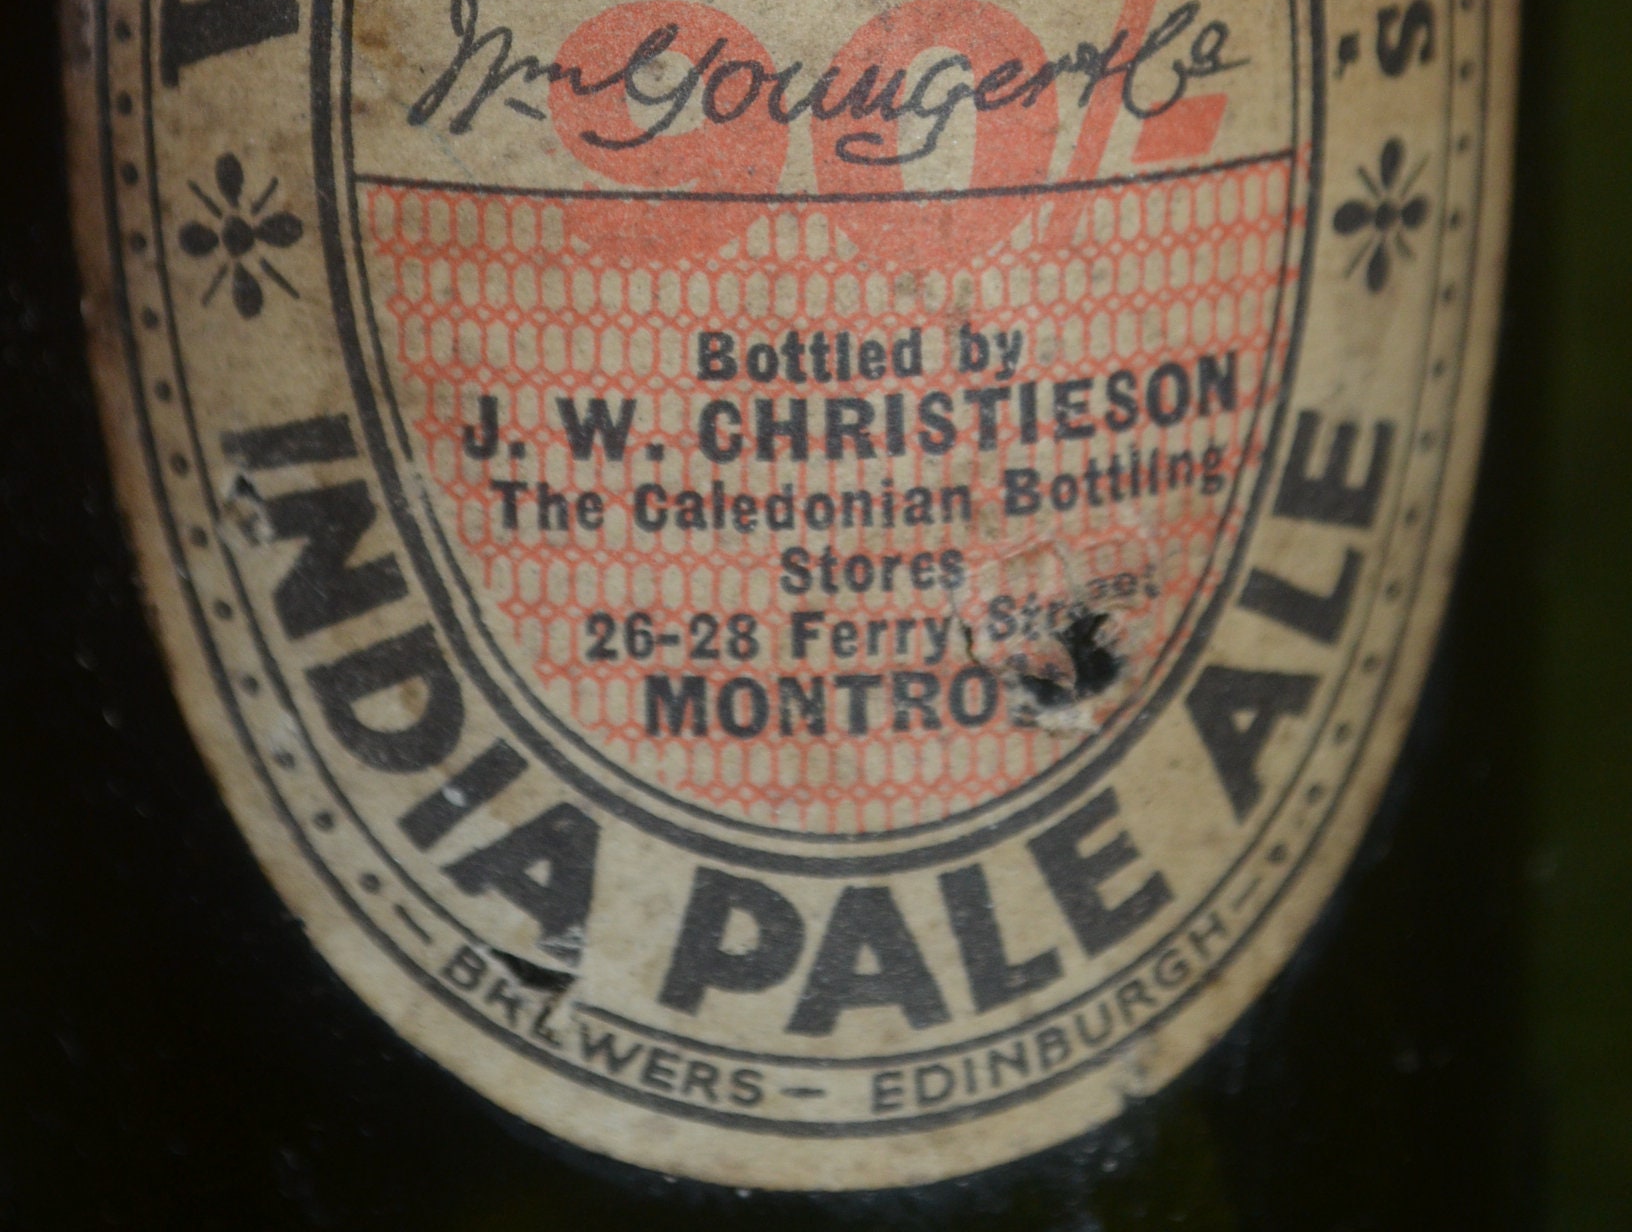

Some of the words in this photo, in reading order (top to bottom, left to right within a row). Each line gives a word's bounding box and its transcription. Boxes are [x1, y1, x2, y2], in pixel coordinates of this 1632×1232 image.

[697, 327, 922, 384] Bottled
[958, 322, 1023, 380] by
[463, 395, 526, 461] J.
[556, 396, 665, 462] W.
[701, 350, 1237, 464] CHRISTIESON
[490, 478, 604, 531] The
[633, 478, 973, 534] Caledonian
[1003, 439, 1226, 516] Bottling
[780, 545, 965, 595] Stores
[585, 612, 761, 661] 26-28
[792, 611, 951, 665] Ferry
[219, 413, 602, 967] INDIA
[657, 786, 1176, 1037] PALE
[1184, 408, 1396, 826] ALE
[644, 658, 1068, 738] MONTRO
[871, 910, 1227, 1115] EDINBURGH
